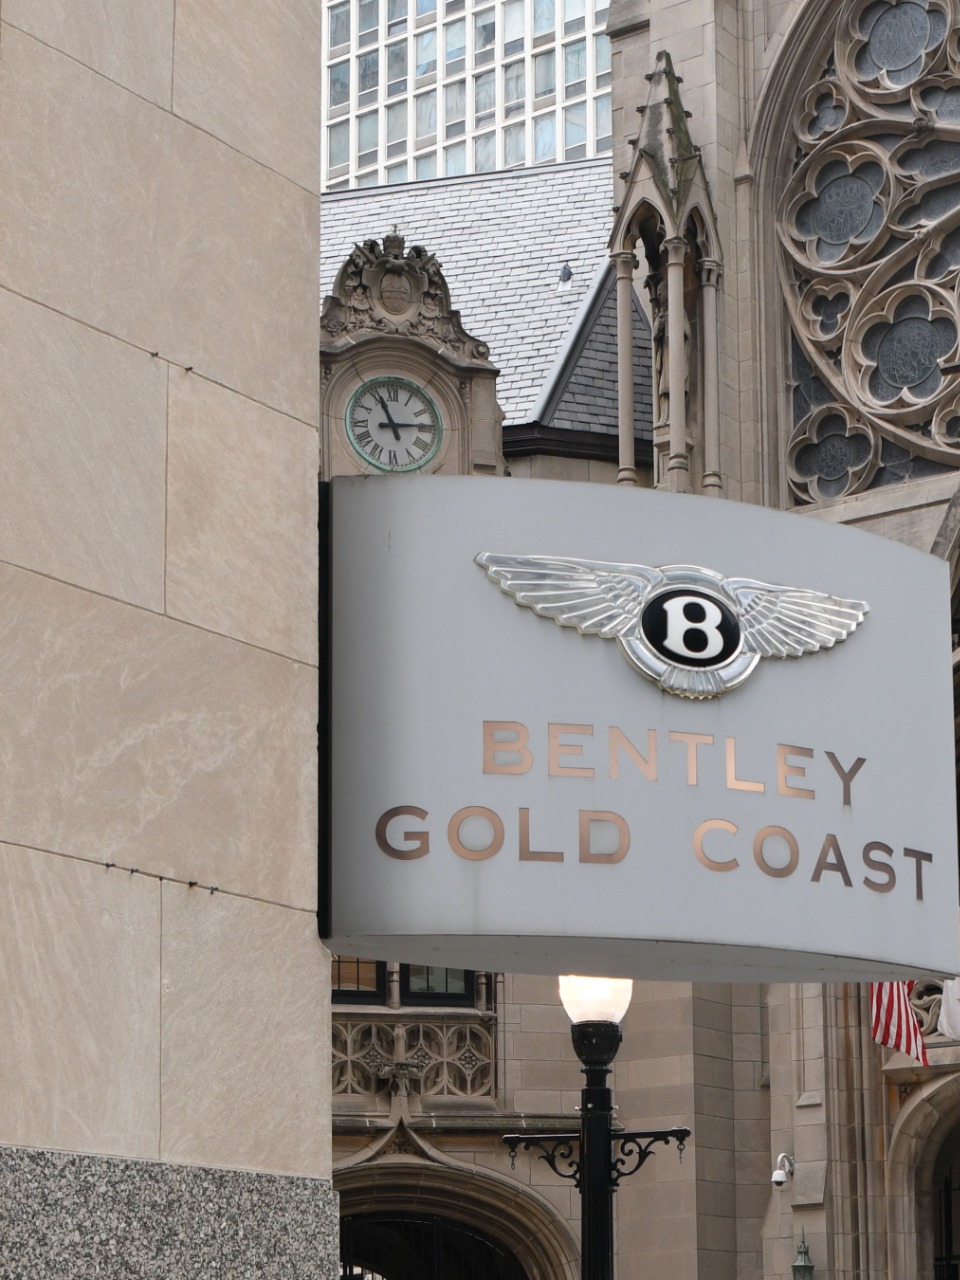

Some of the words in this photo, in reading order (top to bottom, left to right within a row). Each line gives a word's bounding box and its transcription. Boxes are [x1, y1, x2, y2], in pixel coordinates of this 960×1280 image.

[663, 596, 724, 659] B
[482, 720, 867, 807] BENTLEY
[375, 804, 631, 865] GOLD
[692, 817, 934, 901] COAST
